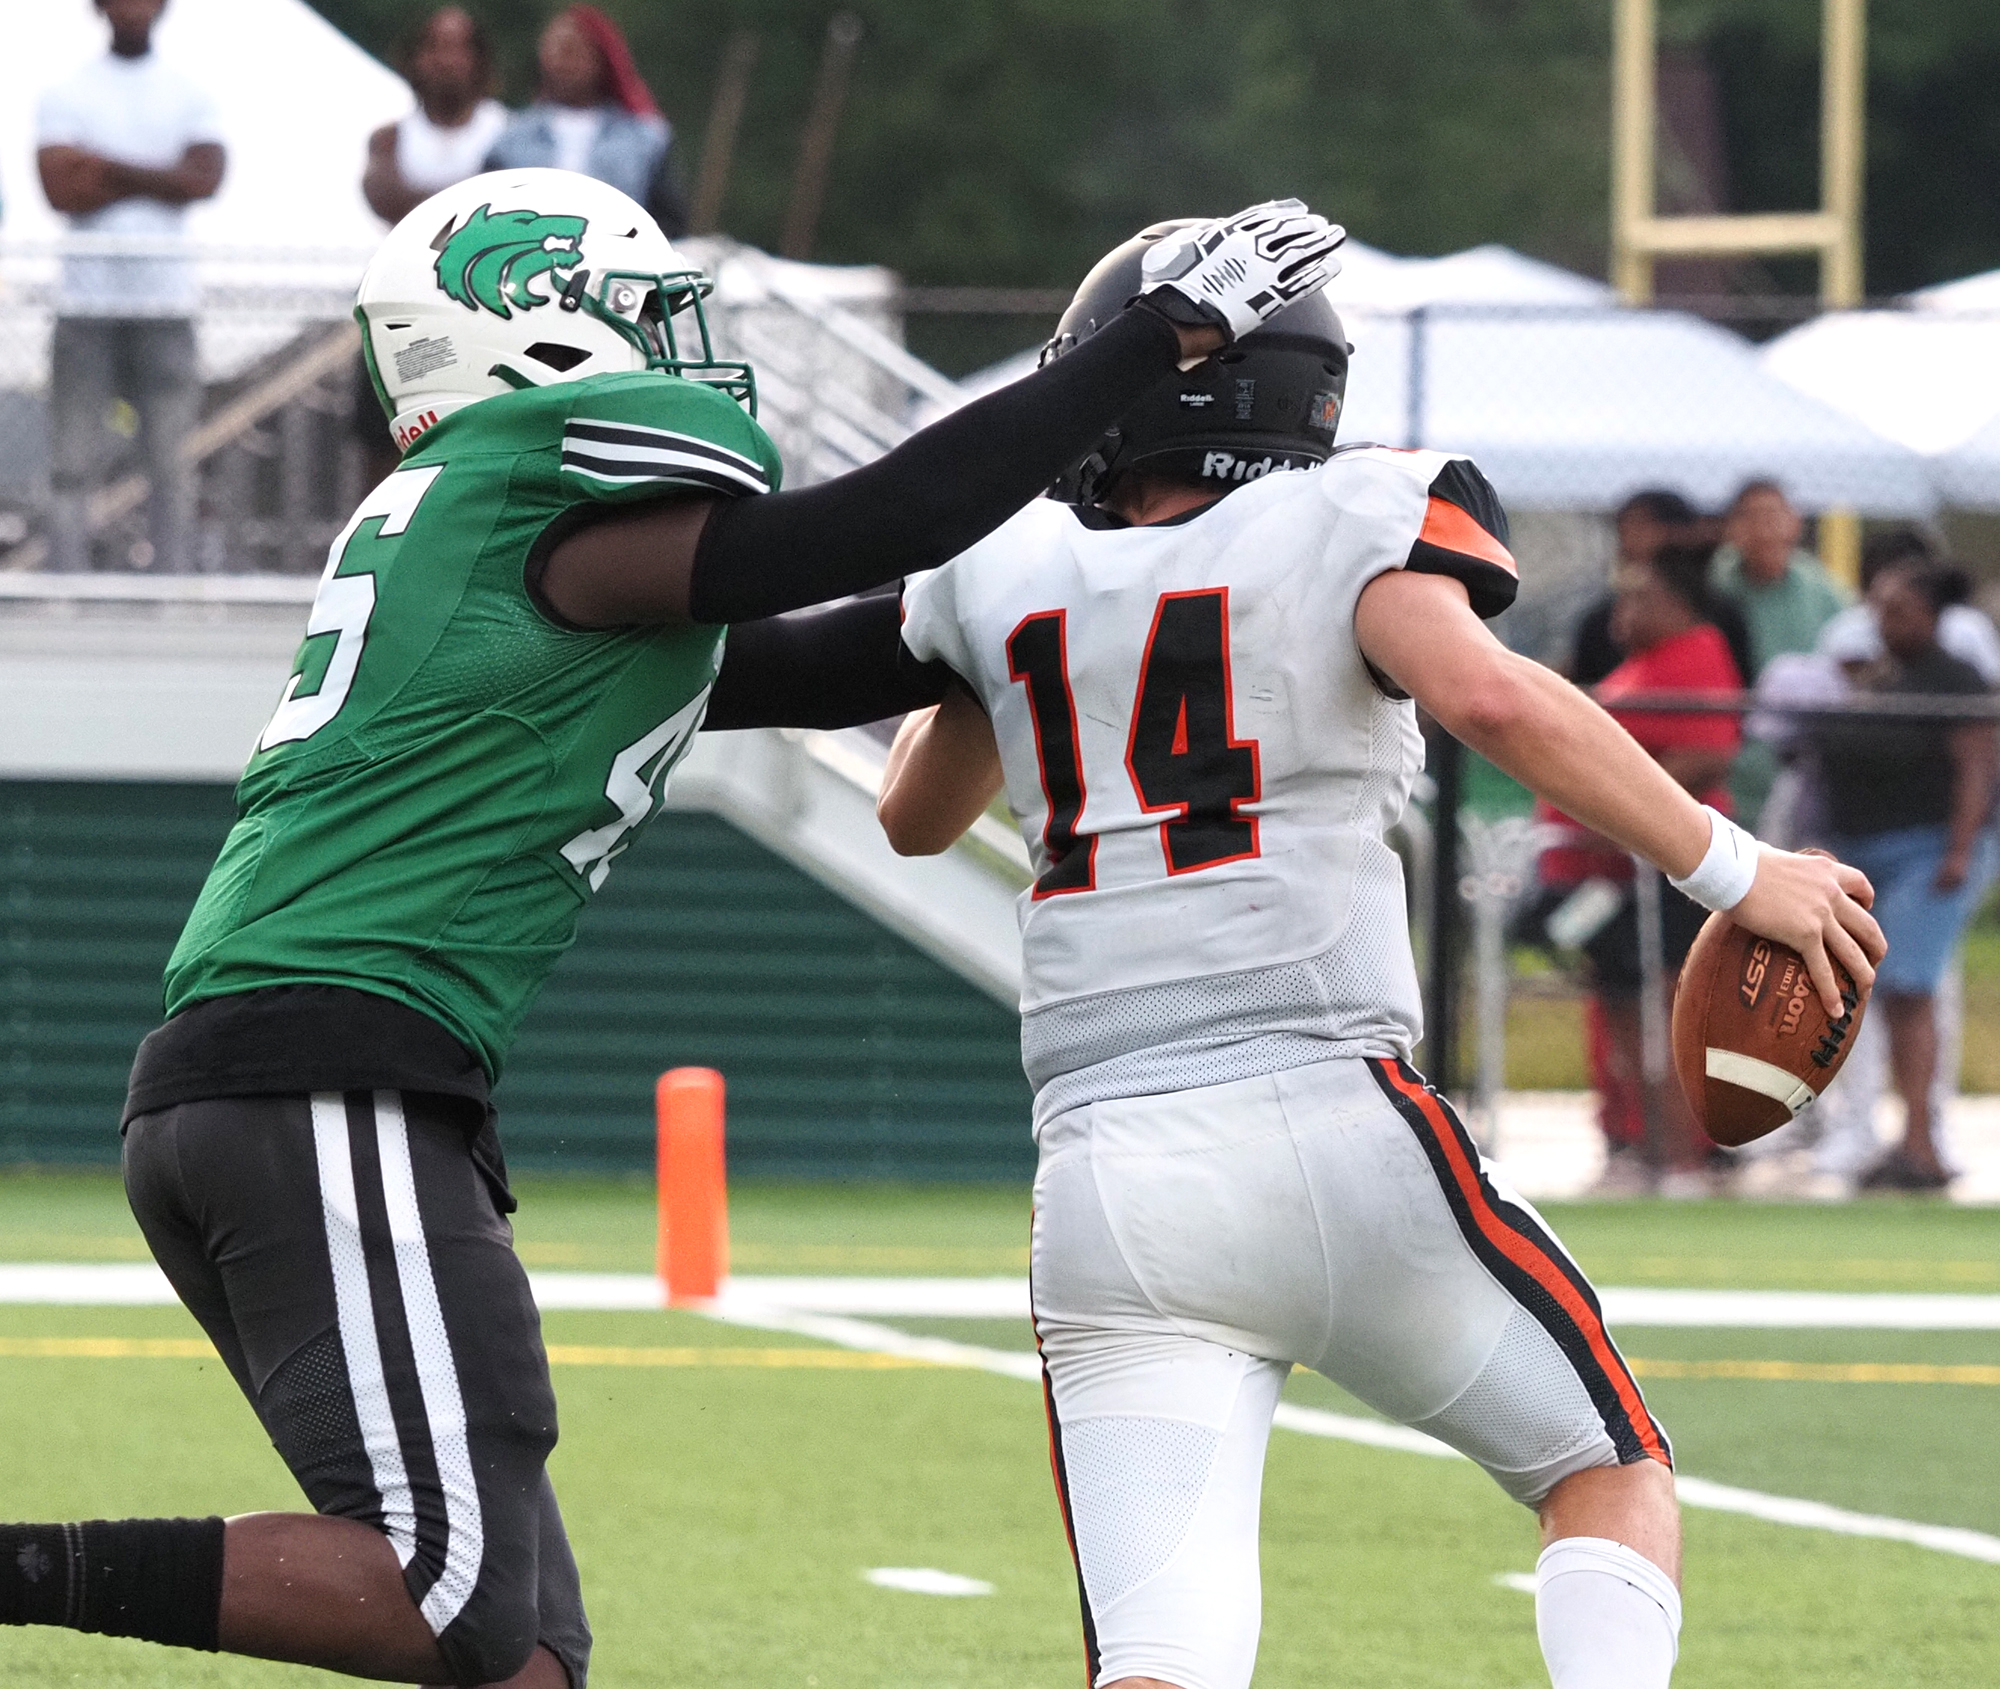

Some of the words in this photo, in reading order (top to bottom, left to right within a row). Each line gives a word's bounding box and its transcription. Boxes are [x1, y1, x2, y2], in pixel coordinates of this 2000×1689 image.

[1180, 393, 1215, 402] Riddell
[1202, 451, 1323, 481] Ridd
[1005, 586, 1262, 902] 14
[1741, 941, 1772, 1006] GST
